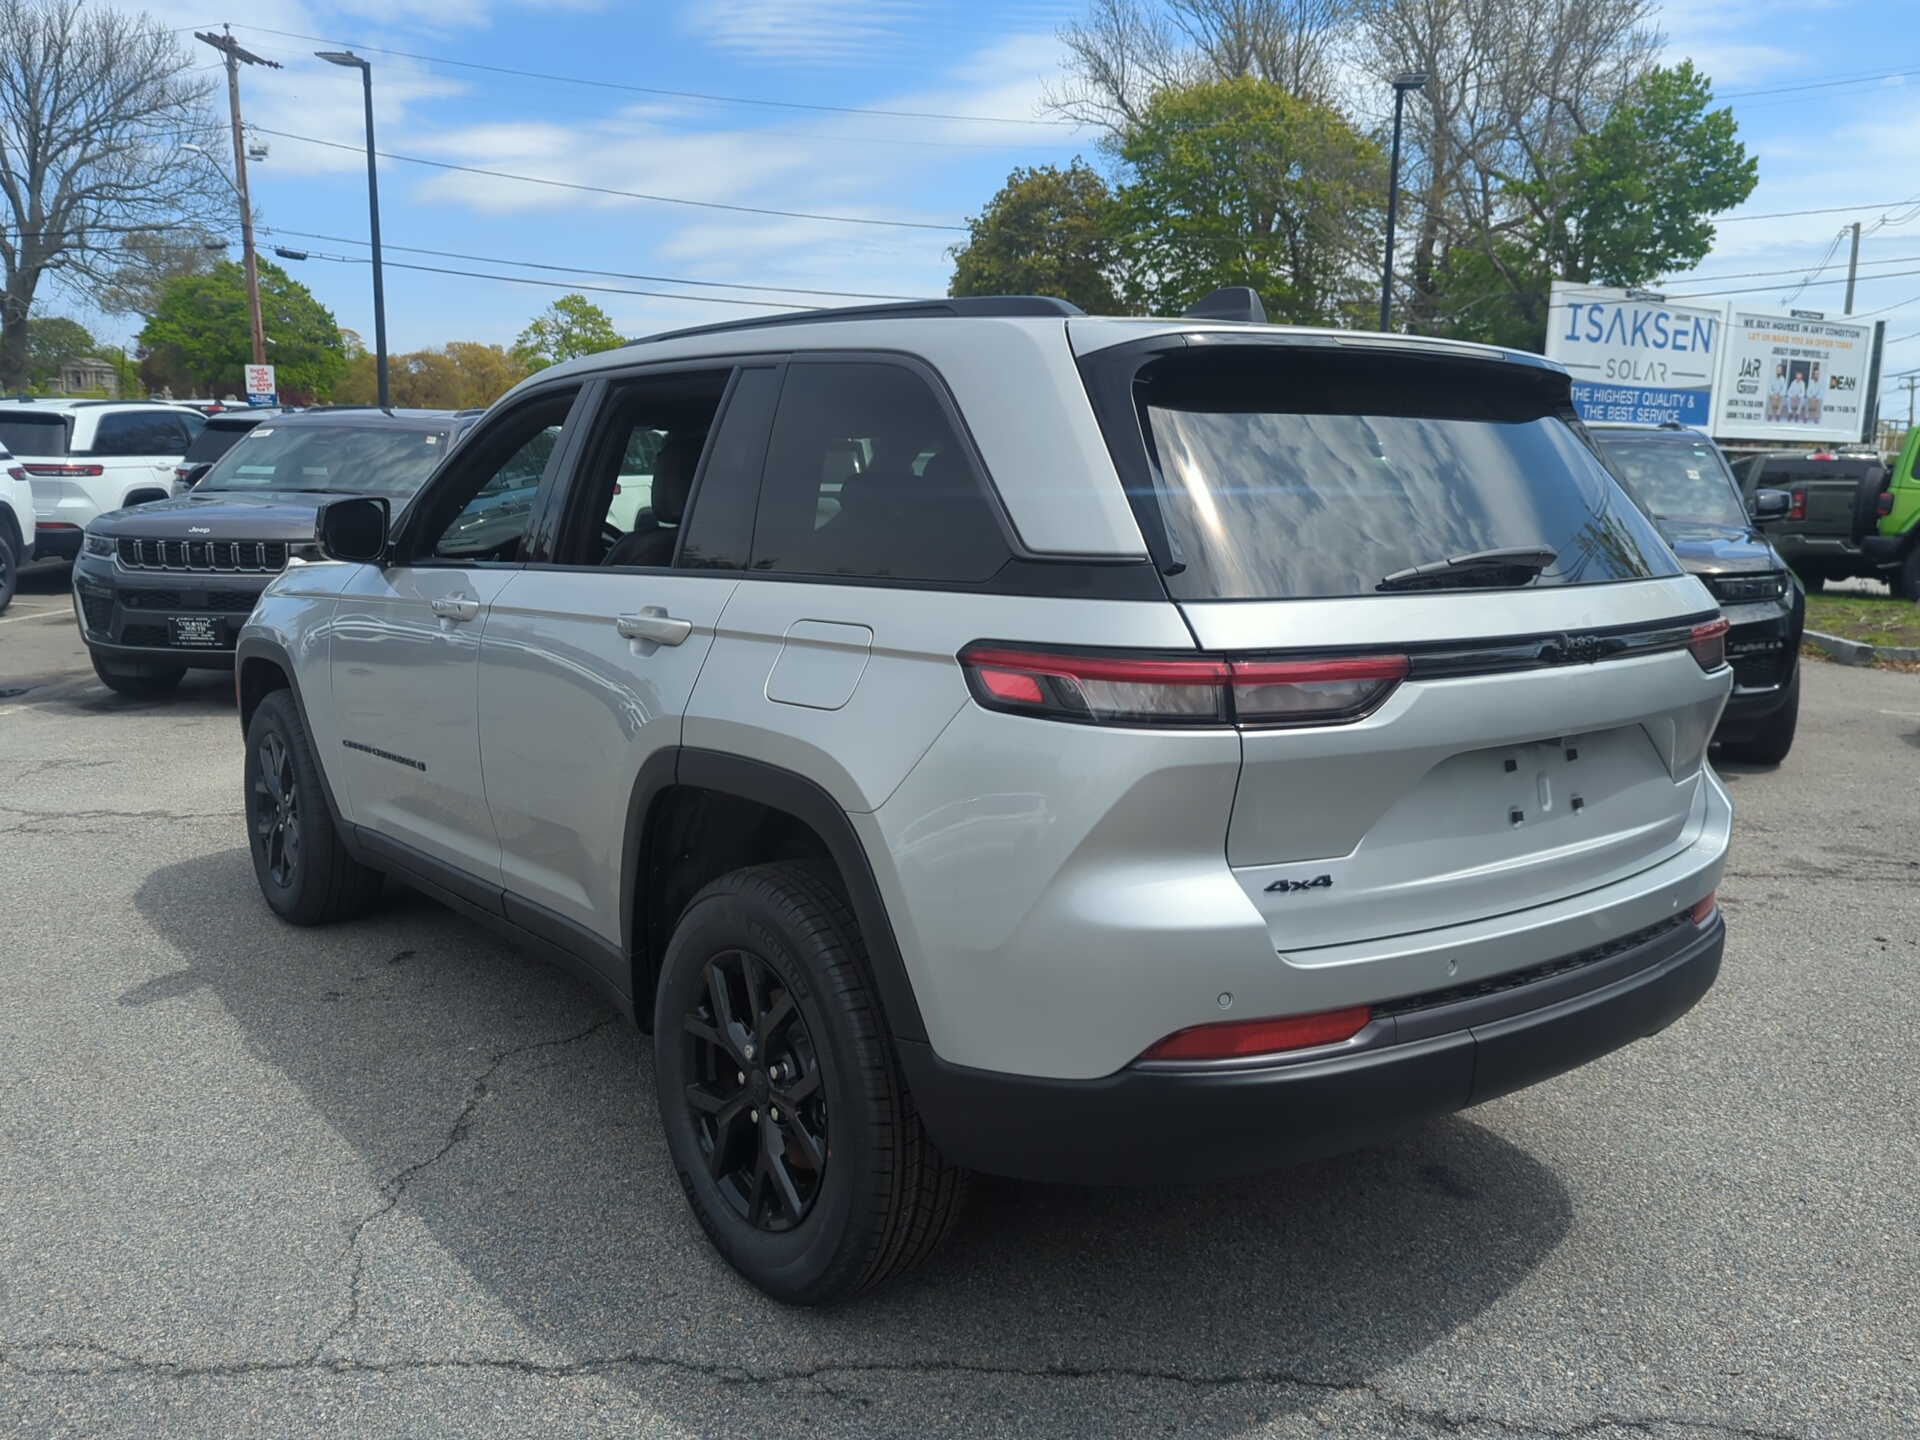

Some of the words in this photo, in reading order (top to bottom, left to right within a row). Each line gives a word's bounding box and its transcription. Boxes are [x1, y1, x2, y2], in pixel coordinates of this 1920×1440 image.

[1564, 302, 1713, 354] ISAKSEN
[1743, 318, 1754, 328] WE
[1756, 320, 1770, 329] BUY
[1772, 321, 1800, 332] HOUSES
[1801, 324, 1809, 333] IN
[1810, 325, 1824, 334] ANY
[1825, 326, 1860, 338] CONDITION
[1748, 332, 1761, 341] LET
[1605, 358, 1667, 383] SOLAR
[1738, 358, 1761, 378] JAR
[1736, 379, 1759, 395] GROUP
[1571, 387, 1590, 402] THE
[1593, 389, 1640, 405] HIGHEST
[1642, 391, 1686, 408] QUALITY
[1687, 395, 1695, 409] &
[1583, 404, 1604, 419] THE
[1607, 406, 1634, 421] BEST
[1637, 408, 1680, 423] SERVICE
[188, 526, 211, 535] Jeep
[1556, 632, 1601, 663] Jeep
[1263, 874, 1334, 893] 4x4
[750, 920, 808, 996] MICHELIN
